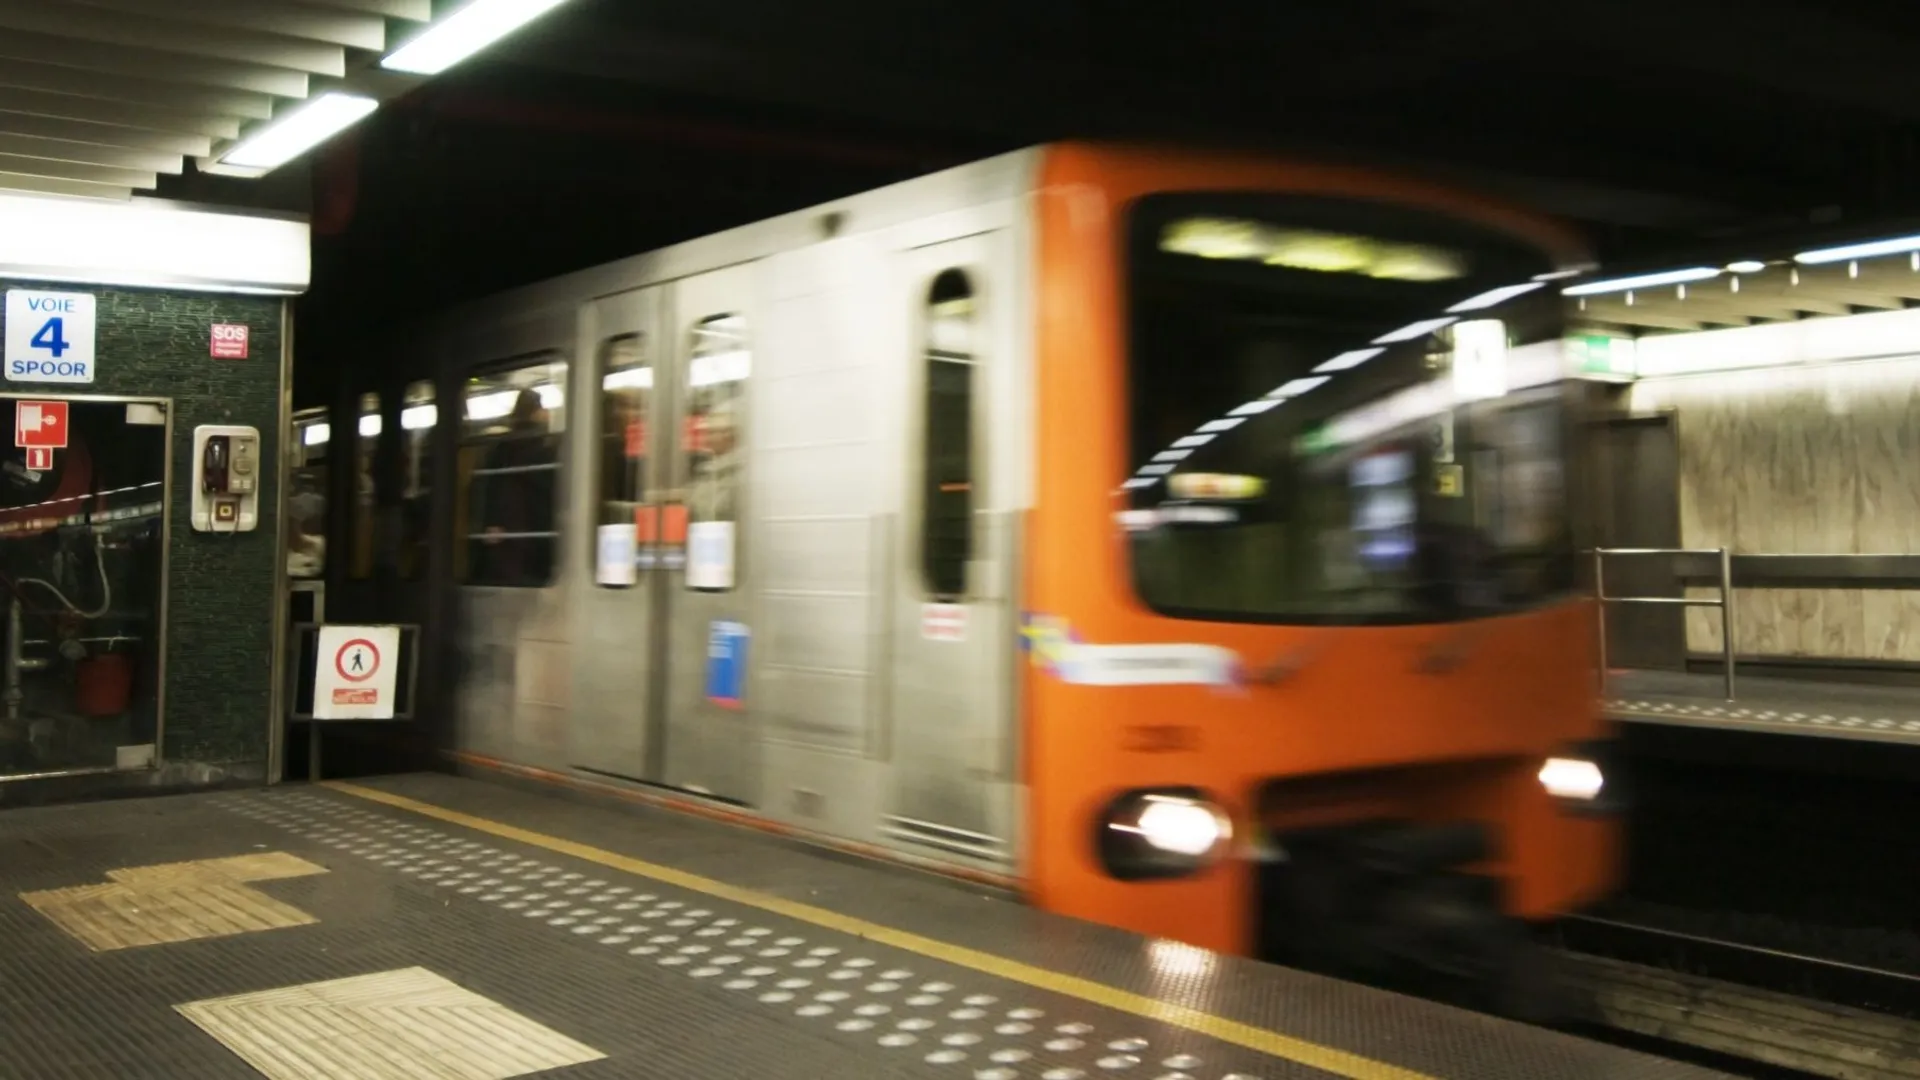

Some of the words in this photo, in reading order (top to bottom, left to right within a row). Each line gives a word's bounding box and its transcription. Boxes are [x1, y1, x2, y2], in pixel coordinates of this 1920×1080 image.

[28, 297, 76, 313] VOIE
[30, 317, 70, 358] 4
[213, 326, 245, 341] SOS
[12, 360, 87, 377] SPOOR
